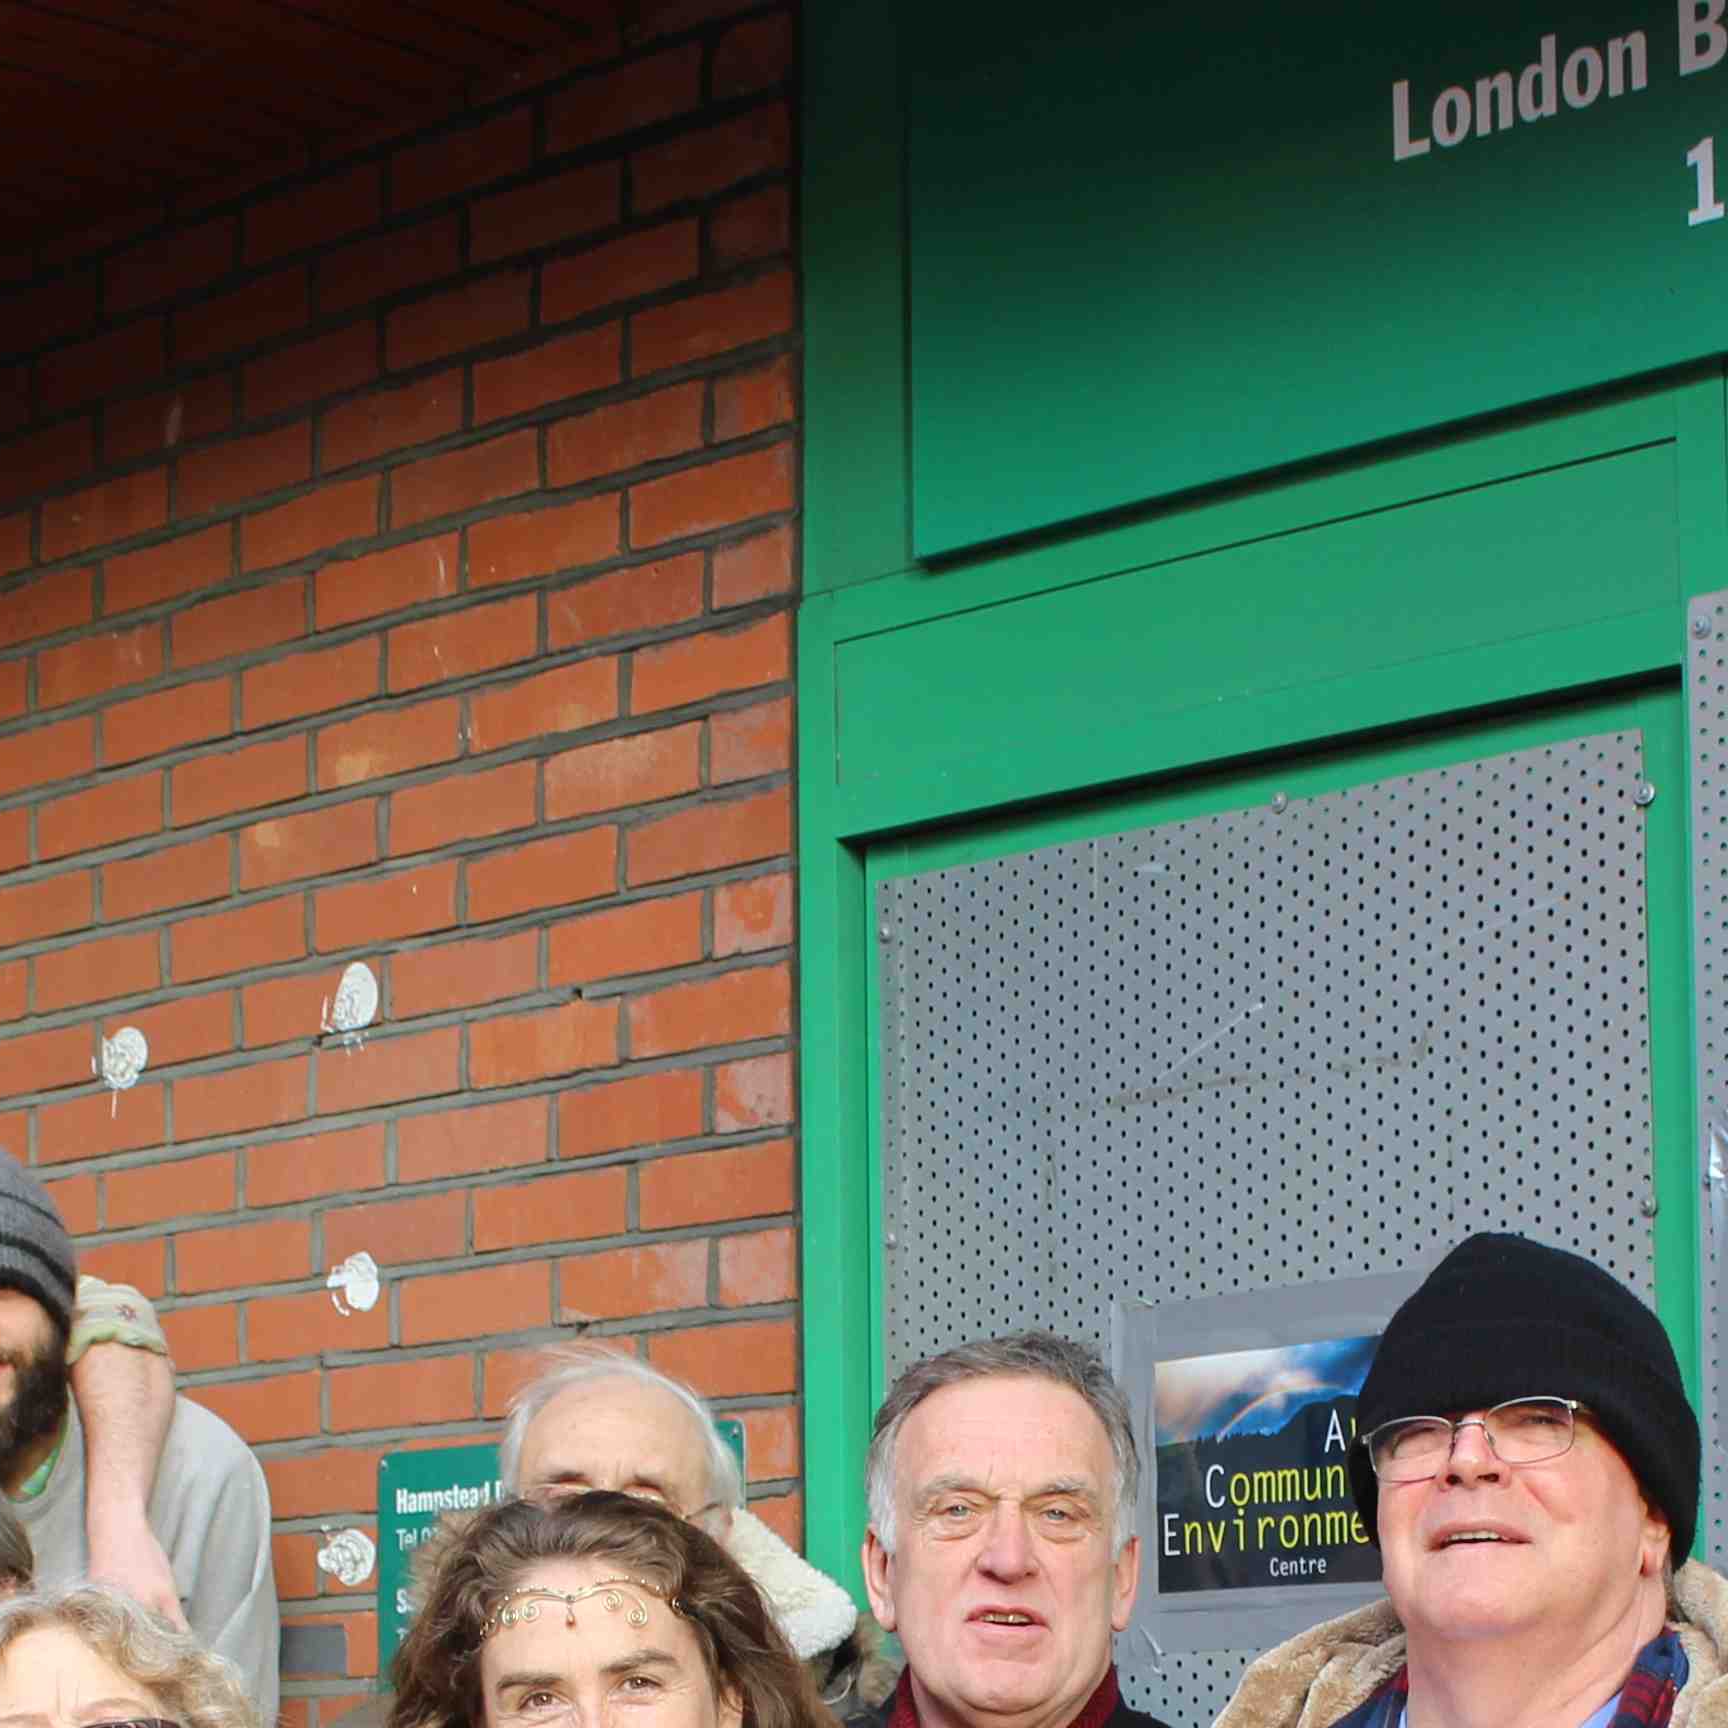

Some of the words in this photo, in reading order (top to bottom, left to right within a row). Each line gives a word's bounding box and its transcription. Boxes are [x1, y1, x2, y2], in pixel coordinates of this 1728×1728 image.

[1391, 28, 1648, 161] London
[396, 1480, 490, 1516] Hampstead
[1270, 1557, 1327, 1577] Centre
